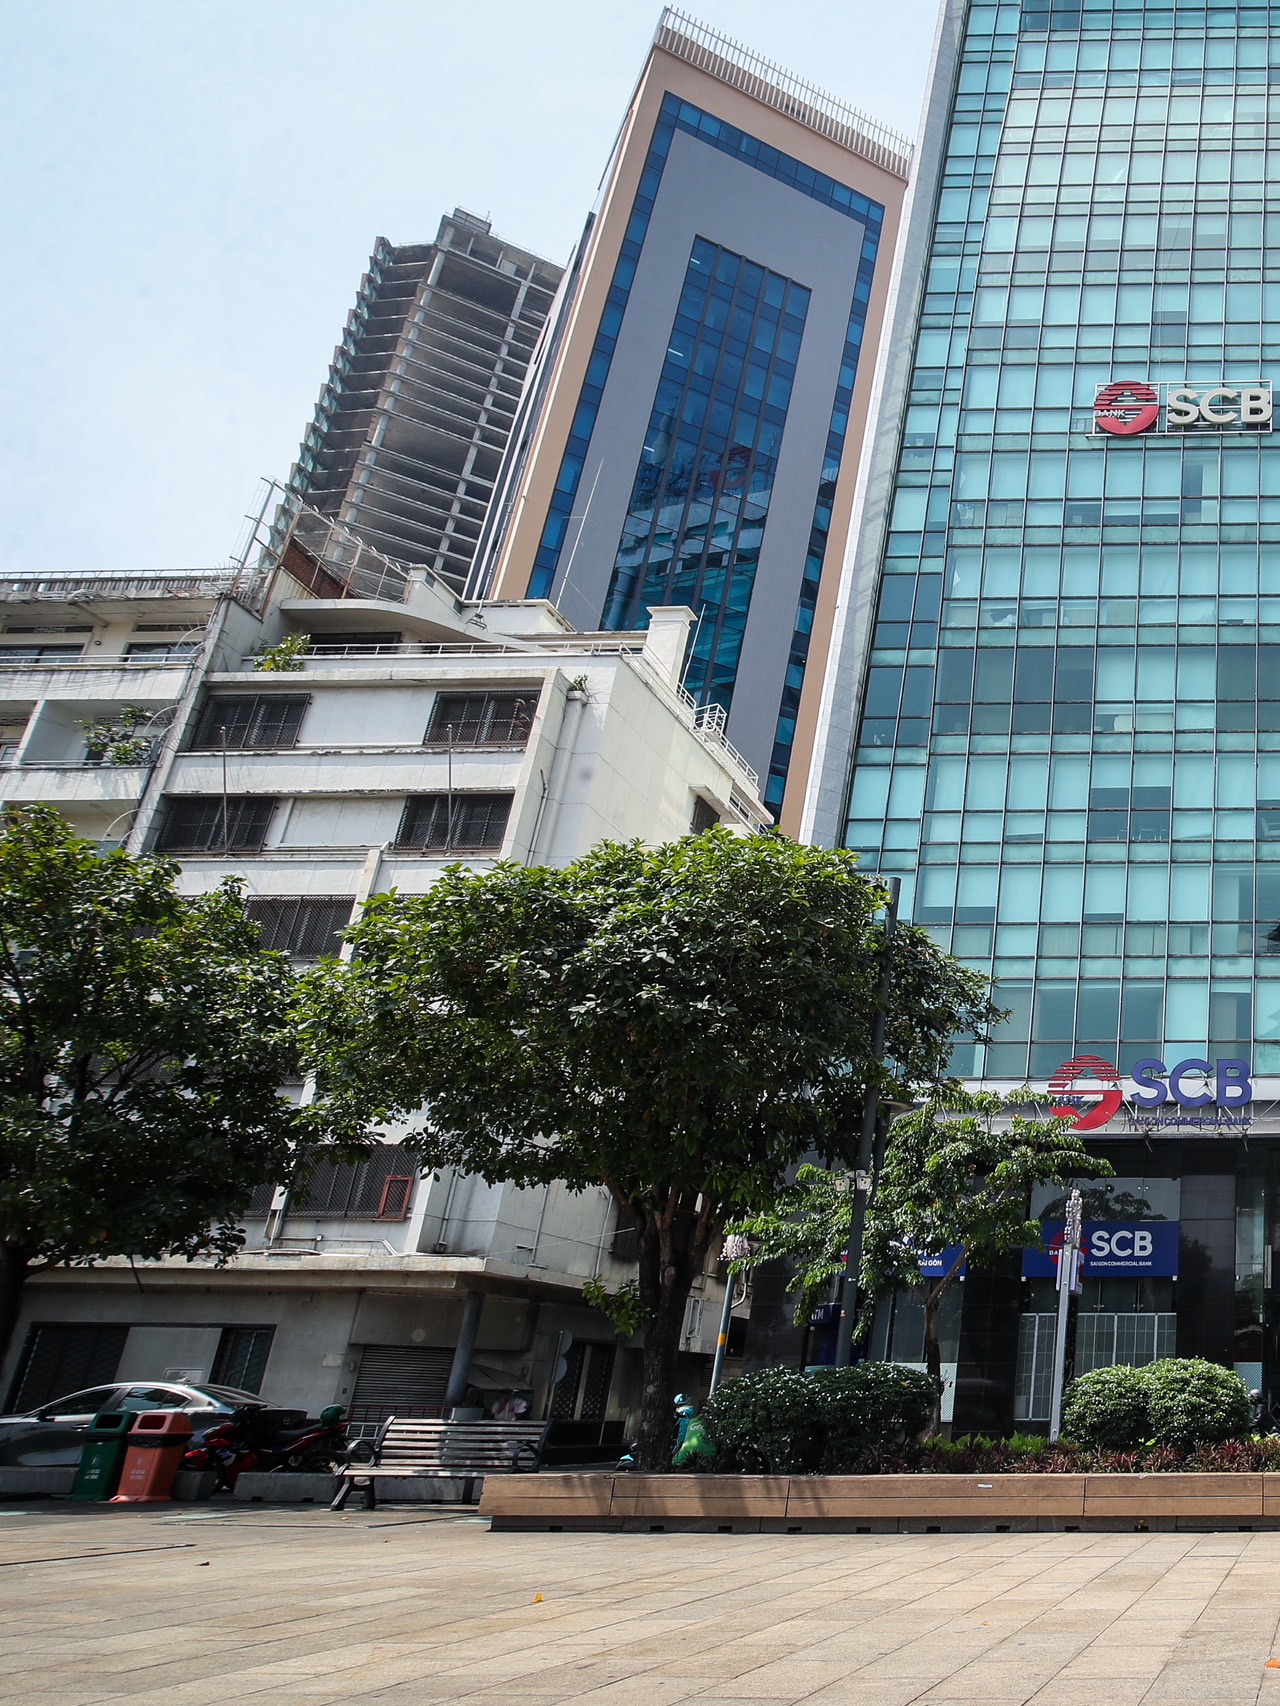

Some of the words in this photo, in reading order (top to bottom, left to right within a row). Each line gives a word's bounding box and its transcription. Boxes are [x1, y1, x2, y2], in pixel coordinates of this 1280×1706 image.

[1095, 409, 1125, 418] BANK
[1168, 388, 1272, 424] SCB
[1130, 1058, 1252, 1108] SCB
[1091, 1230, 1153, 1257] SCB
